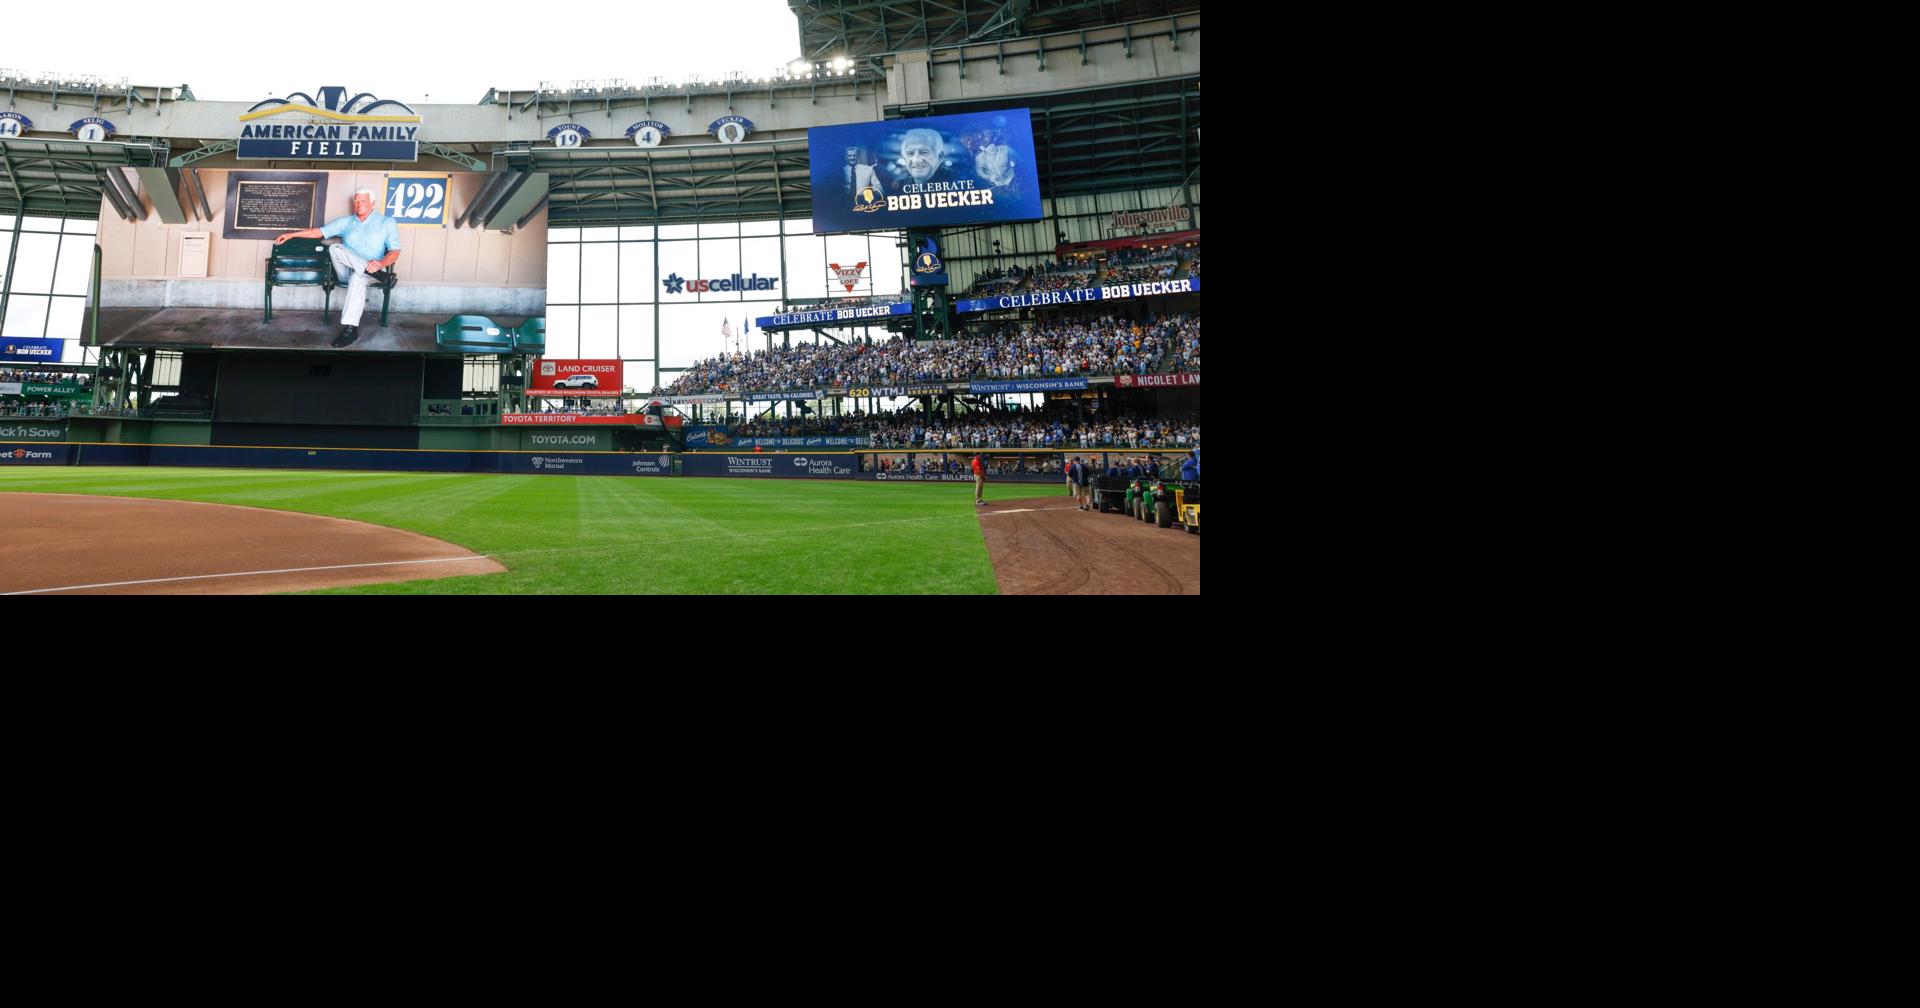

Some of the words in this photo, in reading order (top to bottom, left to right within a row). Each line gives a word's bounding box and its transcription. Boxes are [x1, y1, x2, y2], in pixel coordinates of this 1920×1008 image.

[82, 117, 105, 125] SELIG
[632, 120, 664, 130] MOLITOR
[716, 116, 744, 125] UECKER
[0, 123, 17, 135] 44
[88, 129, 94, 140] 1
[240, 125, 341, 140] AMERICAN
[348, 126, 417, 141] FAMILY
[559, 134, 578, 146] 19
[642, 131, 652, 143] 4
[291, 141, 362, 155] FIELD
[903, 180, 975, 193] CELEBRATE
[386, 182, 444, 219] 422
[887, 194, 922, 211] BOB
[924, 189, 994, 209] UECKER
[1111, 204, 1191, 228] Johnsonville
[1124, 223, 1150, 232] PARY
[1154, 221, 1177, 229] DECK
[834, 269, 862, 277] VIZZY
[685, 272, 780, 297] uscellular
[999, 288, 1096, 309] CELEBRATE
[1101, 284, 1131, 299] BOB
[1133, 279, 1193, 297] UECKER
[773, 310, 834, 326] CELEBRATE
[836, 308, 855, 320] BOB
[855, 305, 891, 318] UECKER
[558, 365, 581, 373] LAND
[581, 365, 616, 373] CRUISER
[1137, 375, 1178, 386] NICOLET
[1181, 374, 1200, 384] LAW
[970, 384, 1009, 392] WINTRUST
[1016, 381, 1063, 390] WISCONSIN'S
[1064, 380, 1084, 388] BANK
[849, 388, 869, 397] 620
[871, 387, 905, 396] WTMJ
[503, 415, 533, 423] TOYOTA
[534, 415, 577, 423] TERRITORY
[28, 427, 60, 437] Save
[531, 435, 596, 444] TOYOTA.COM
[727, 456, 773, 466] WINTRUST
[808, 458, 832, 466] Aurora
[808, 466, 833, 474] Health
[833, 466, 850, 474] Care
